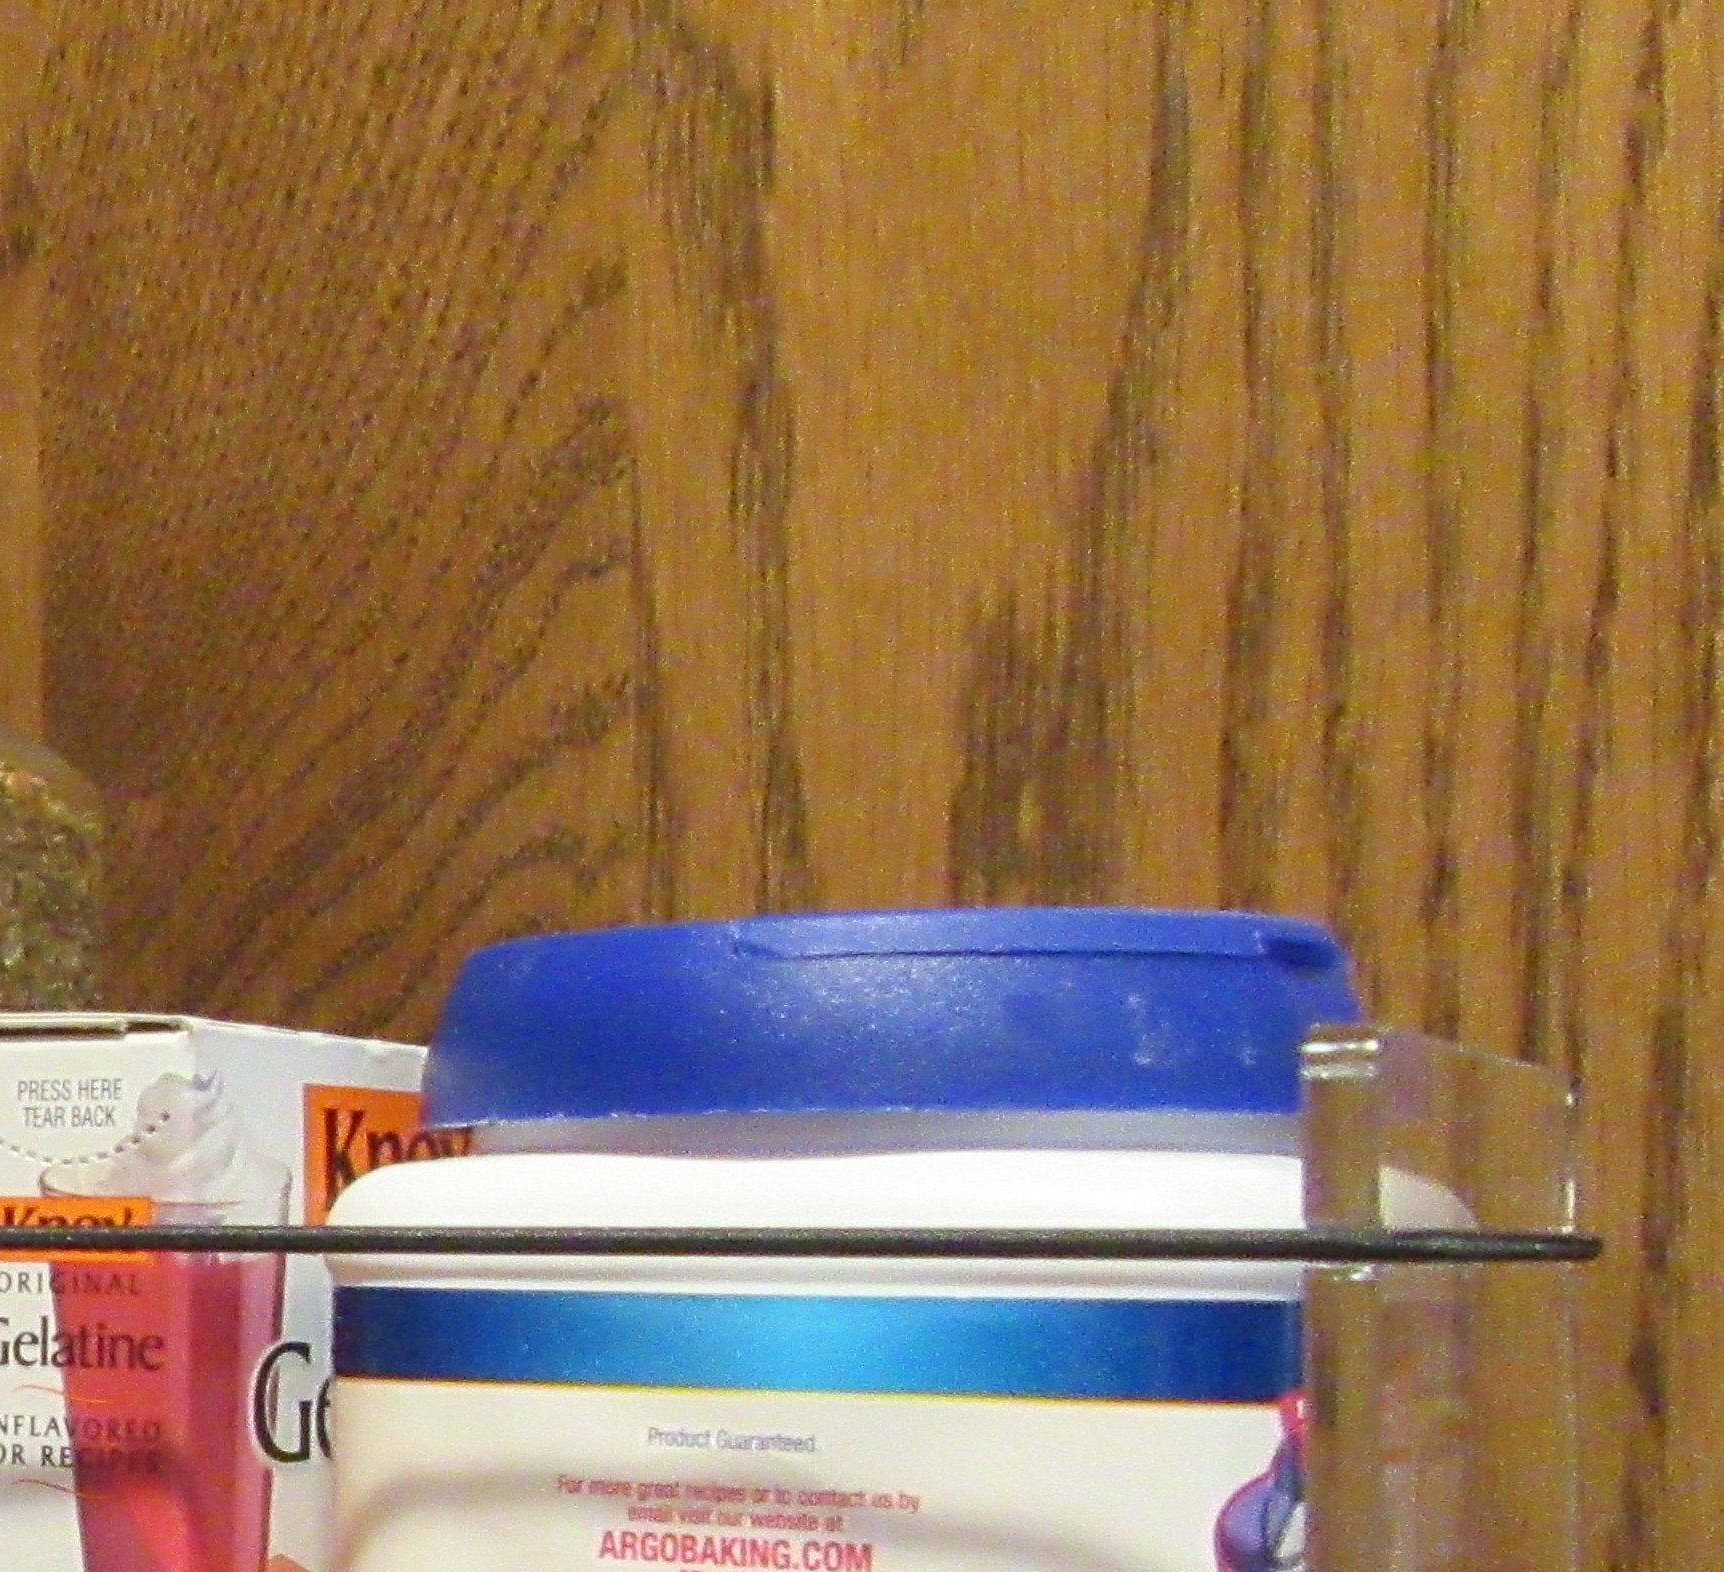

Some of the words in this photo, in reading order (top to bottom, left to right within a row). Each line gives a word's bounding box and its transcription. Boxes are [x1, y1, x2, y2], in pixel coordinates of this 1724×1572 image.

[17, 1079, 71, 1101] PRESS
[77, 1078, 123, 1101] HERE
[23, 1106, 66, 1128] TEAR
[71, 1106, 116, 1128] BACK
[648, 1427, 711, 1448] Product
[715, 1429, 819, 1454] Guaranteed.
[557, 1474, 583, 1495] For
[588, 1479, 632, 1497] more
[636, 1481, 681, 1502] great
[684, 1483, 746, 1504] recipes
[751, 1487, 771, 1503] or
[775, 1487, 793, 1504] to
[796, 1489, 866, 1508] contact
[871, 1493, 894, 1510] us
[898, 1491, 921, 1515] by
[627, 1504, 674, 1523] email
[678, 1507, 712, 1525] visit
[750, 1512, 819, 1532] website
[824, 1514, 844, 1533] at
